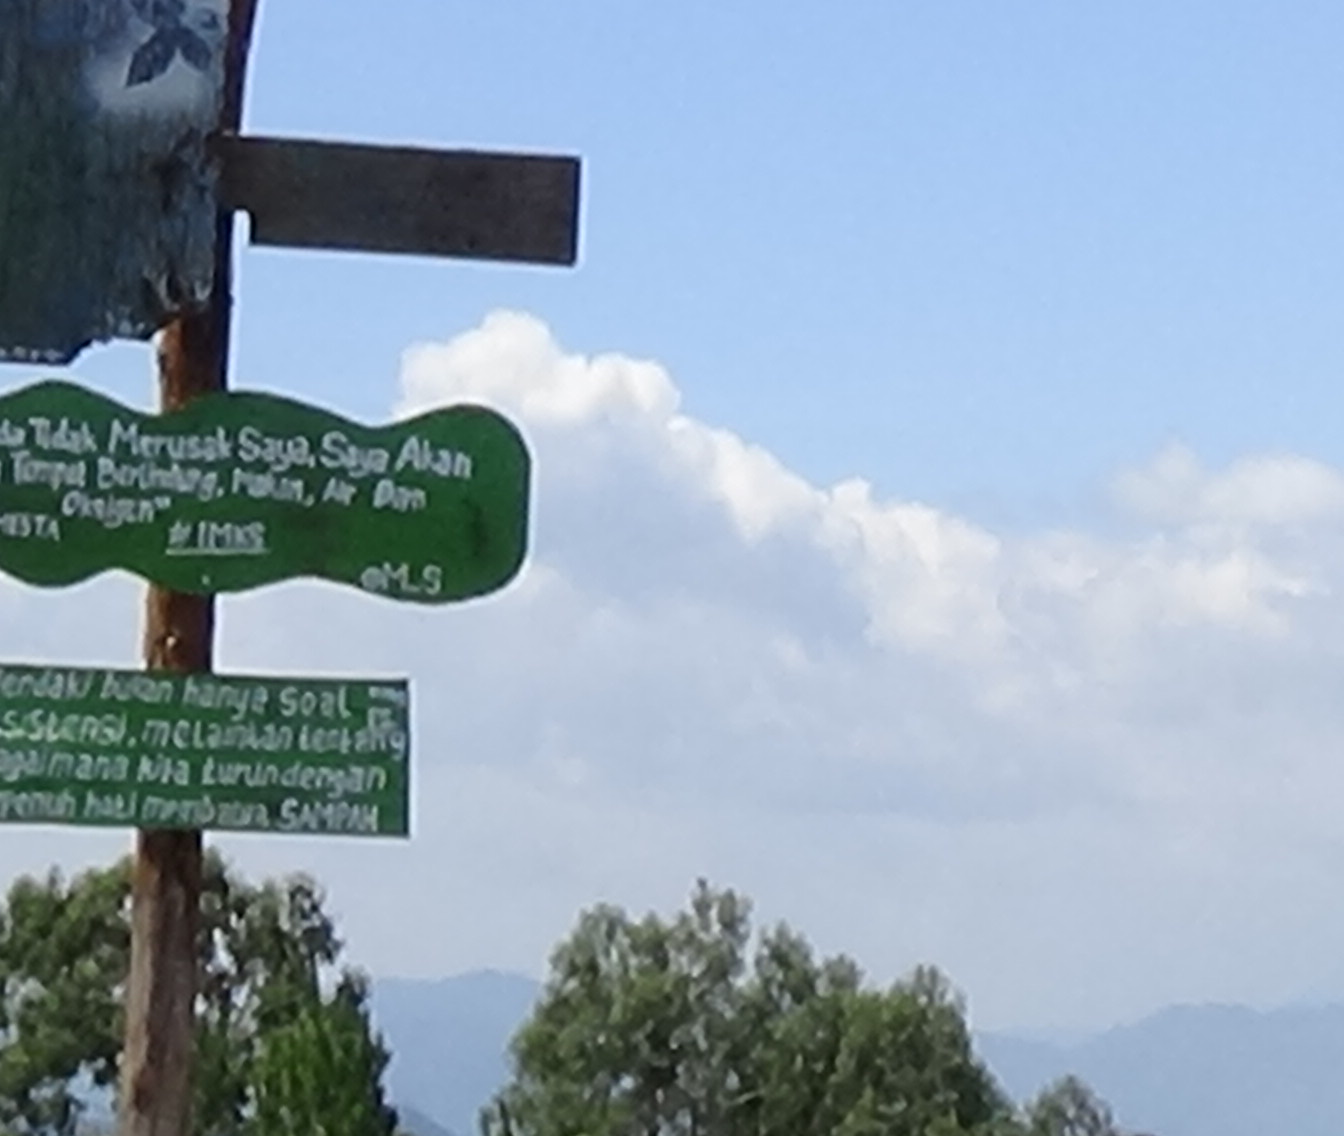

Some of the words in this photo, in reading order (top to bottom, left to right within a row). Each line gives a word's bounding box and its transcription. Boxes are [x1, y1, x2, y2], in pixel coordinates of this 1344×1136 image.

[108, 417, 234, 463] Merusak
[320, 430, 390, 478] Saya
[394, 434, 473, 480] Akan
